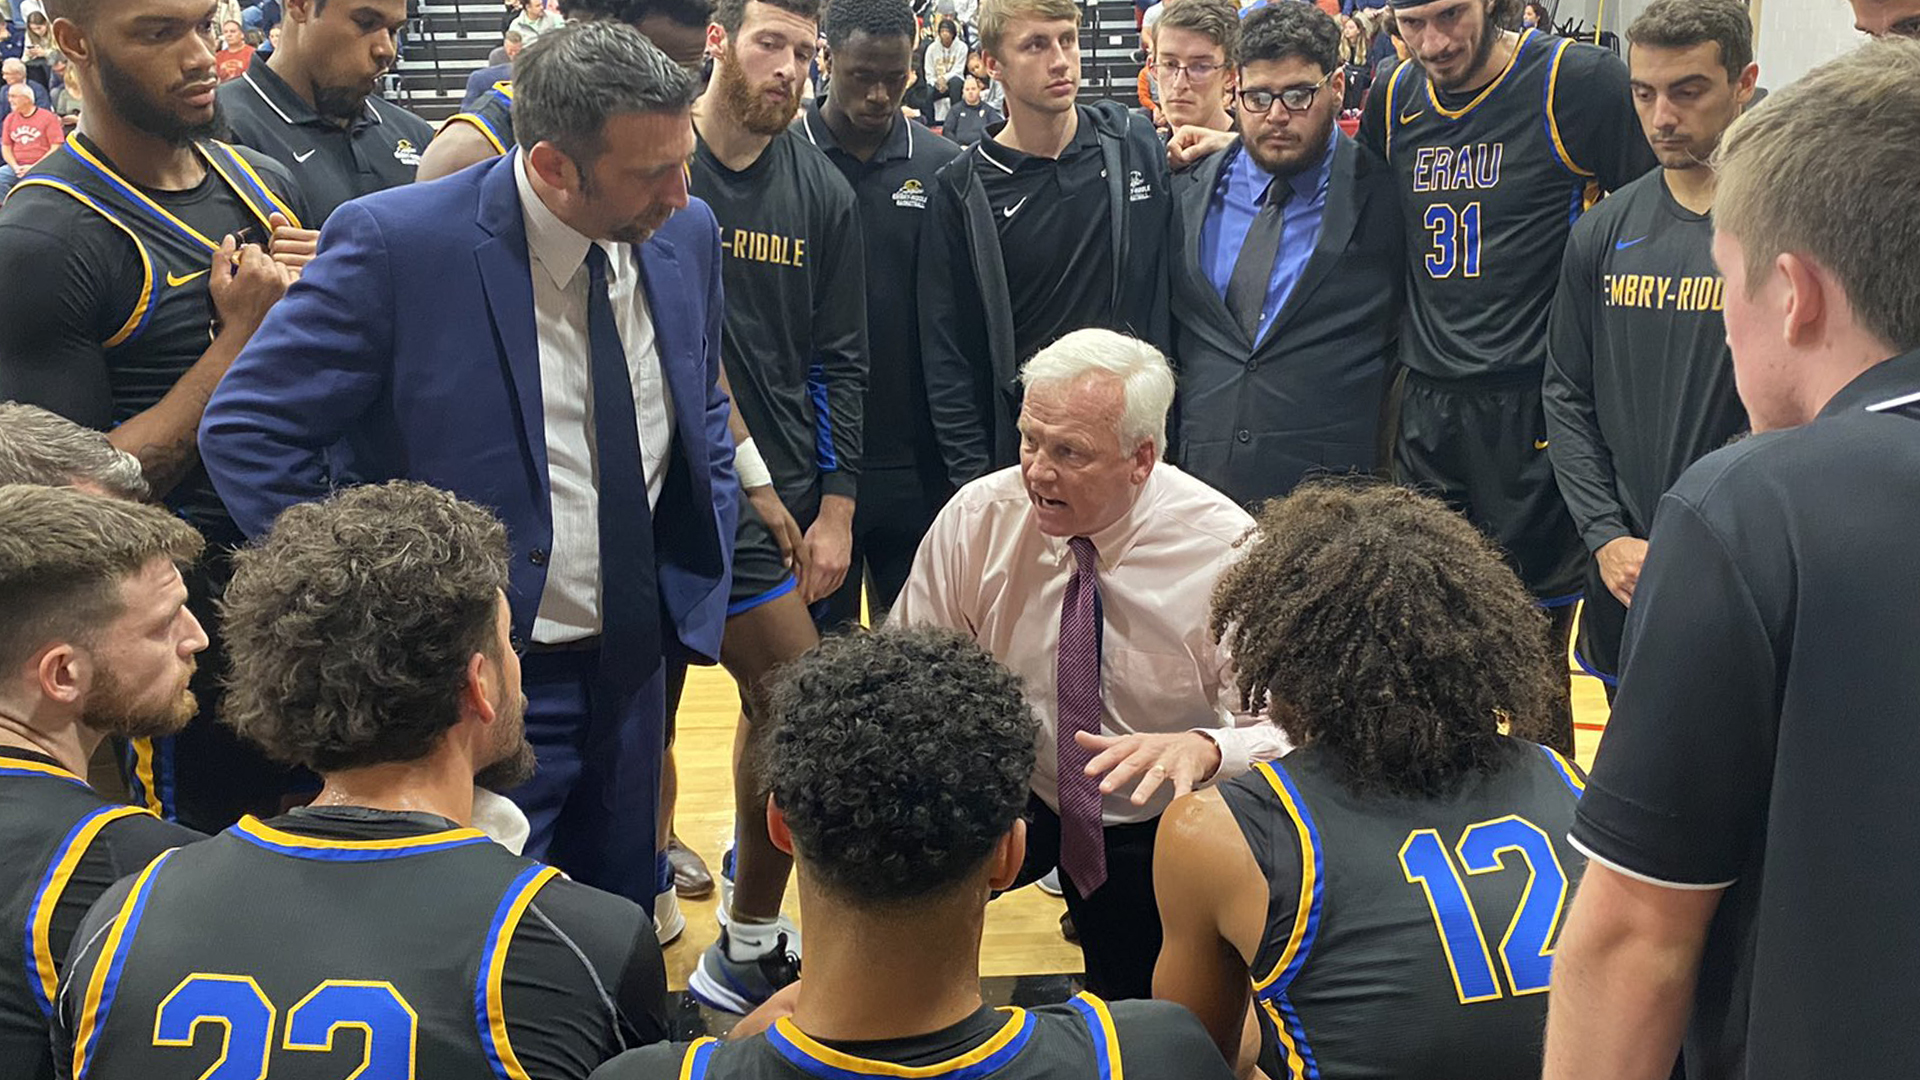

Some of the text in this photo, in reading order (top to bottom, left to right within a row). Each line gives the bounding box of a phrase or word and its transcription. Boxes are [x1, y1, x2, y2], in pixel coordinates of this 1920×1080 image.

[1413, 143, 1504, 192] ERAU
[1424, 201, 1481, 278] 31
[1397, 813, 1569, 1004] 12
[152, 971, 419, 1080] 22
